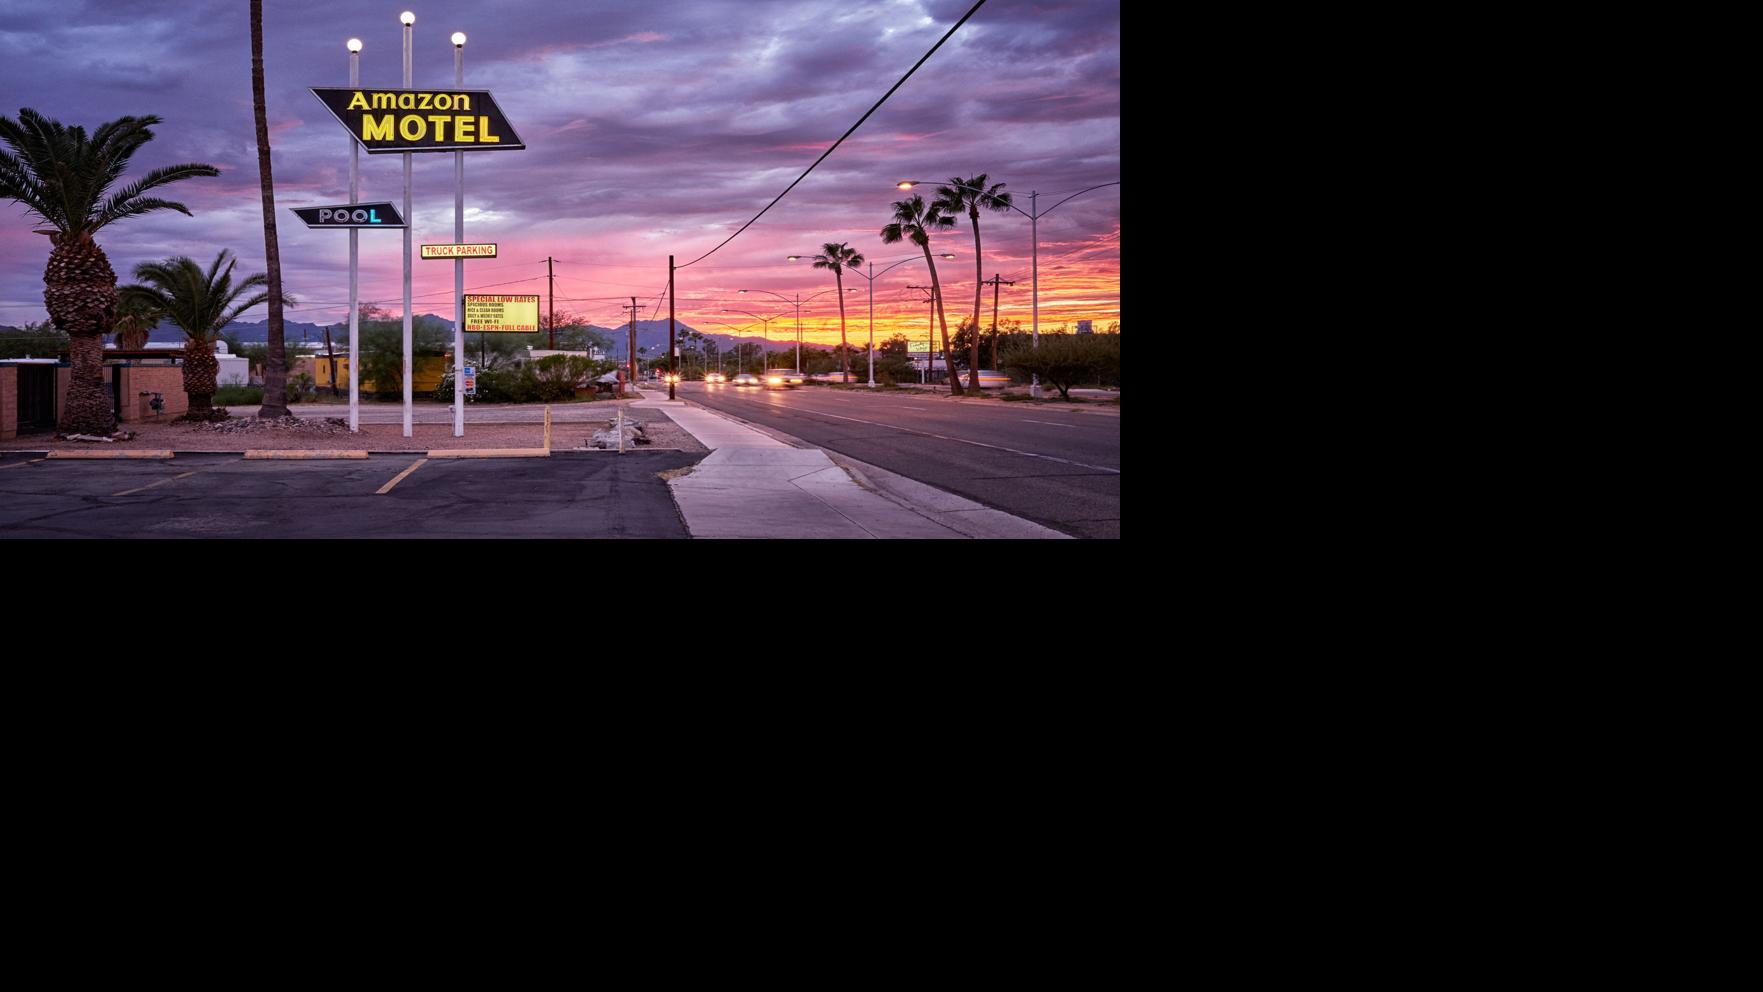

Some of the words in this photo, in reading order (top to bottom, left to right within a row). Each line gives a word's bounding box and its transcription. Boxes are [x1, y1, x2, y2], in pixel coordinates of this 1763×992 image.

[347, 91, 470, 111] Amazon
[362, 114, 500, 143] MOTEL
[319, 208, 382, 223] POOL
[426, 246, 454, 255] TRUCK
[456, 246, 493, 254] PARKING
